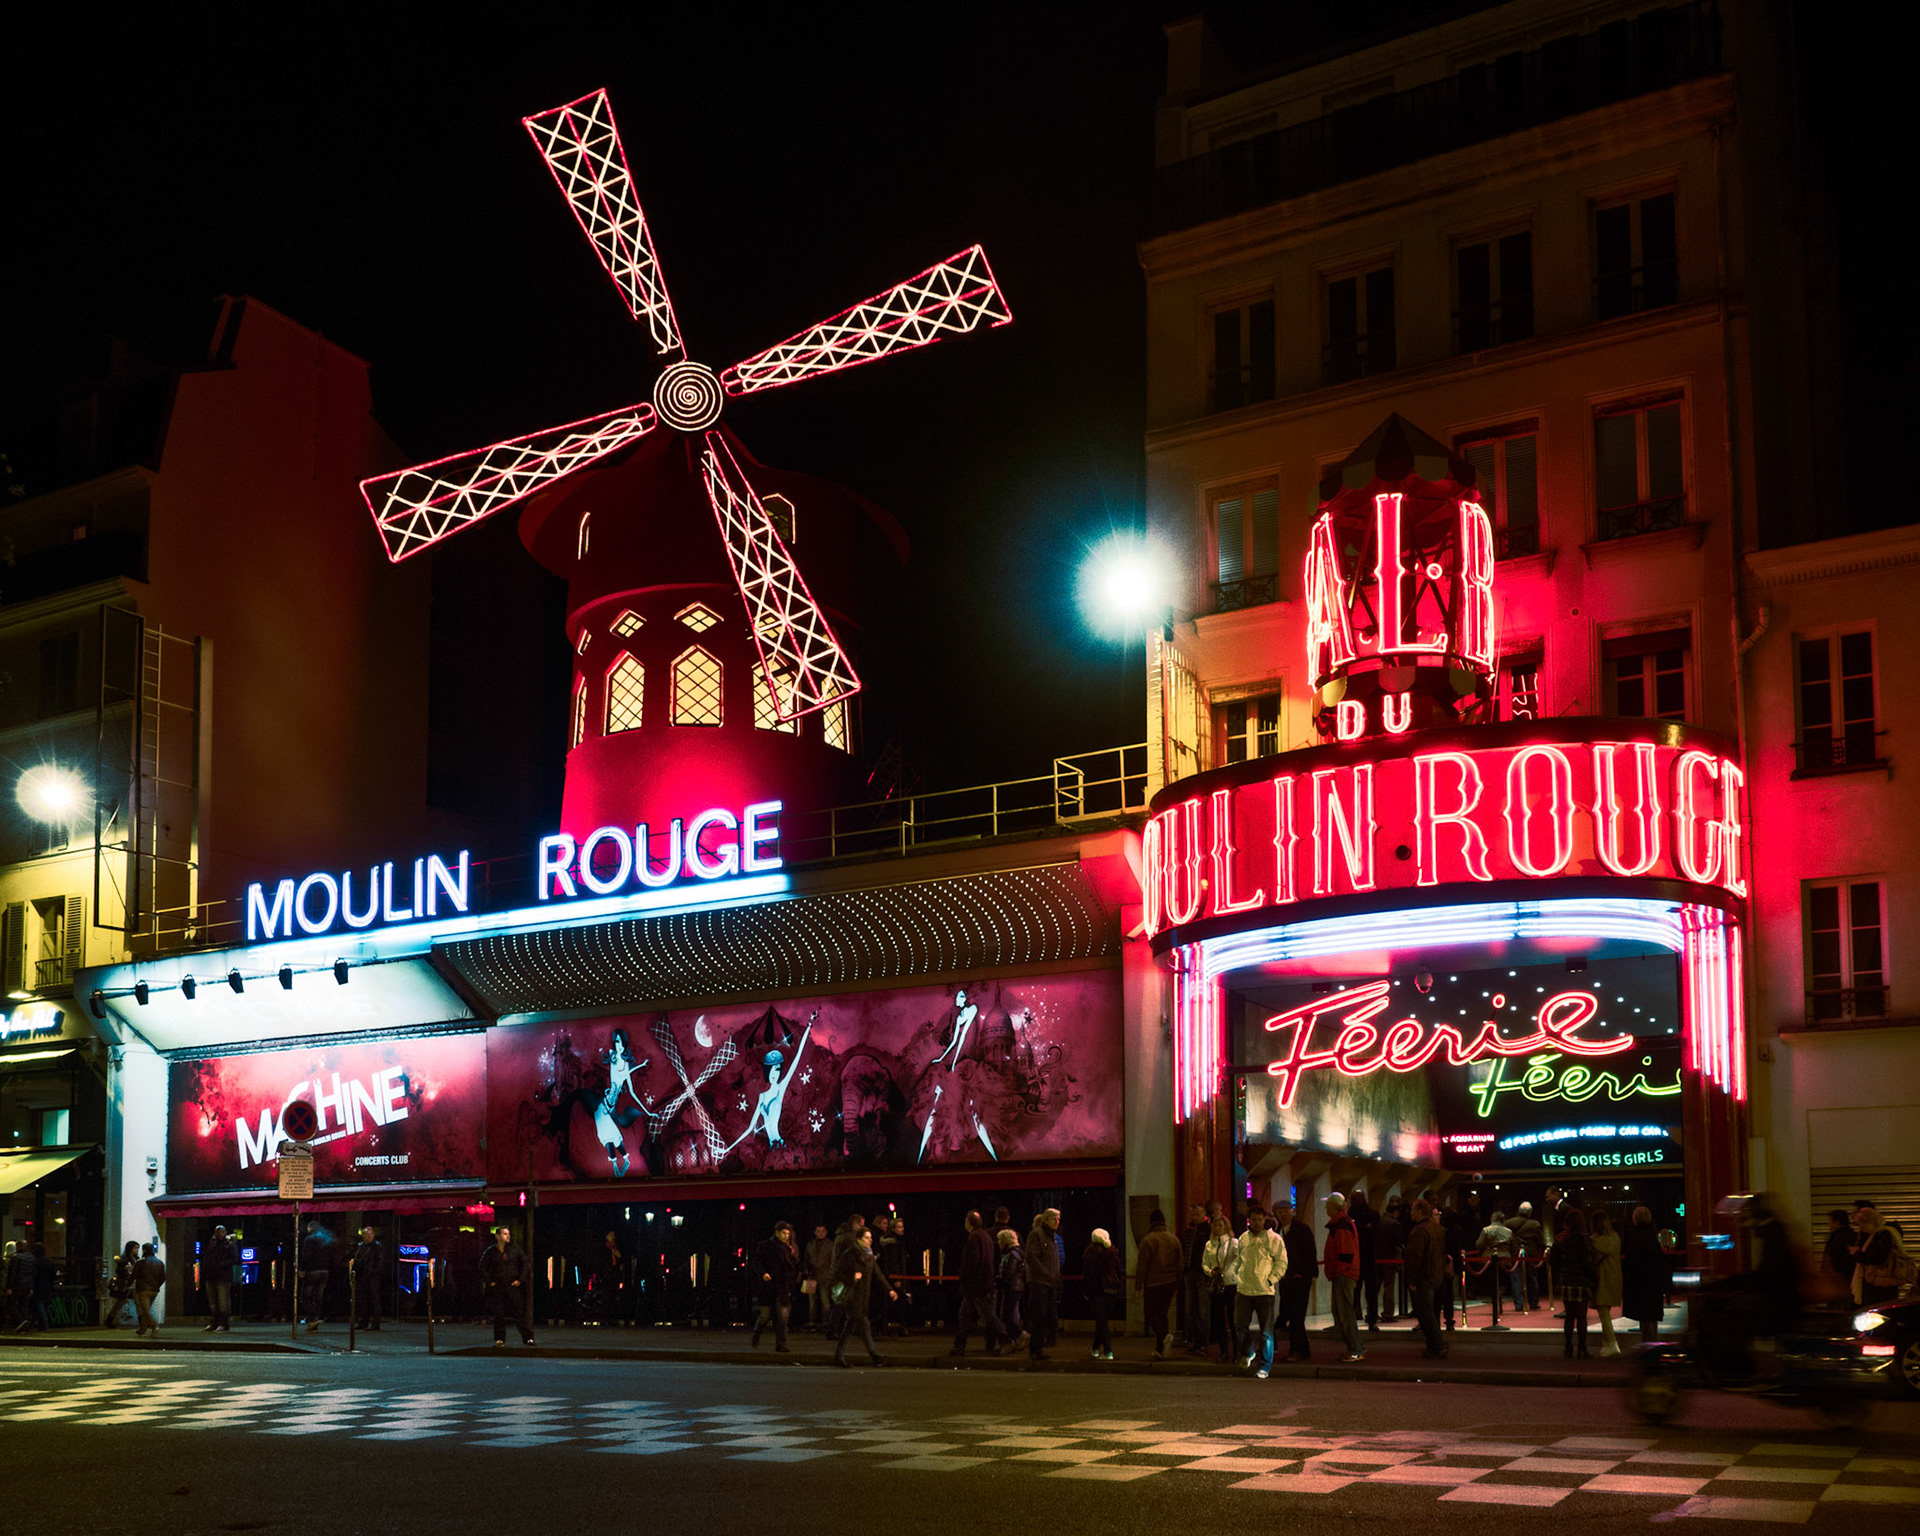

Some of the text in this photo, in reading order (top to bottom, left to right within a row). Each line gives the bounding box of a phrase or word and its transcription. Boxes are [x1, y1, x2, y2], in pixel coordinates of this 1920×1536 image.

[1337, 692, 1412, 740] DU
[1414, 744, 1747, 899] ROUGE
[247, 800, 785, 941] MOULIN ROUGE
[1265, 980, 1634, 1109] Féerie
[1469, 1054, 1682, 1117] Féeri
[355, 1155, 409, 1167] CONCERTS CLUB
[1542, 1149, 1664, 1167] LES DORISS GIRLS
